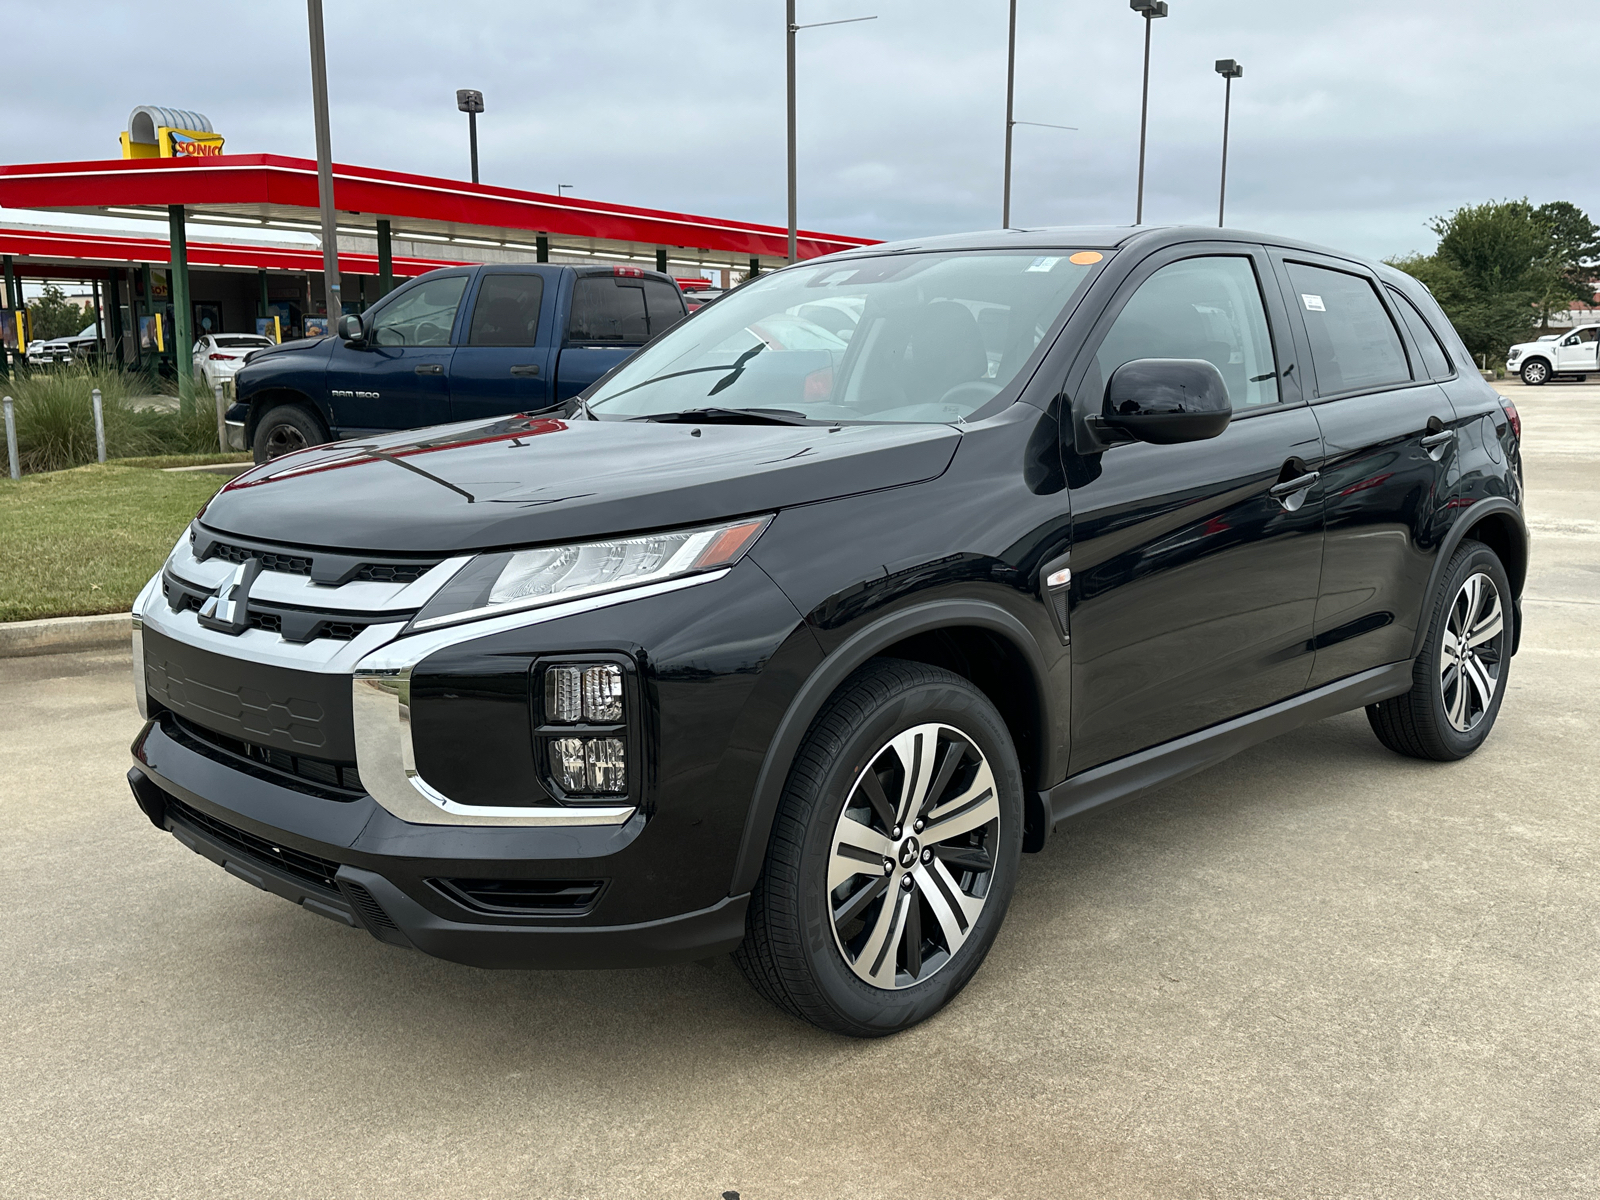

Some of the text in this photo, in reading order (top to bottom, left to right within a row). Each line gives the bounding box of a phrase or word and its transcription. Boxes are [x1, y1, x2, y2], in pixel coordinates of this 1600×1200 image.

[178, 141, 220, 157] SONIC
[331, 390, 380, 399] RAM 1500
[805, 793, 838, 954] NEXEN
